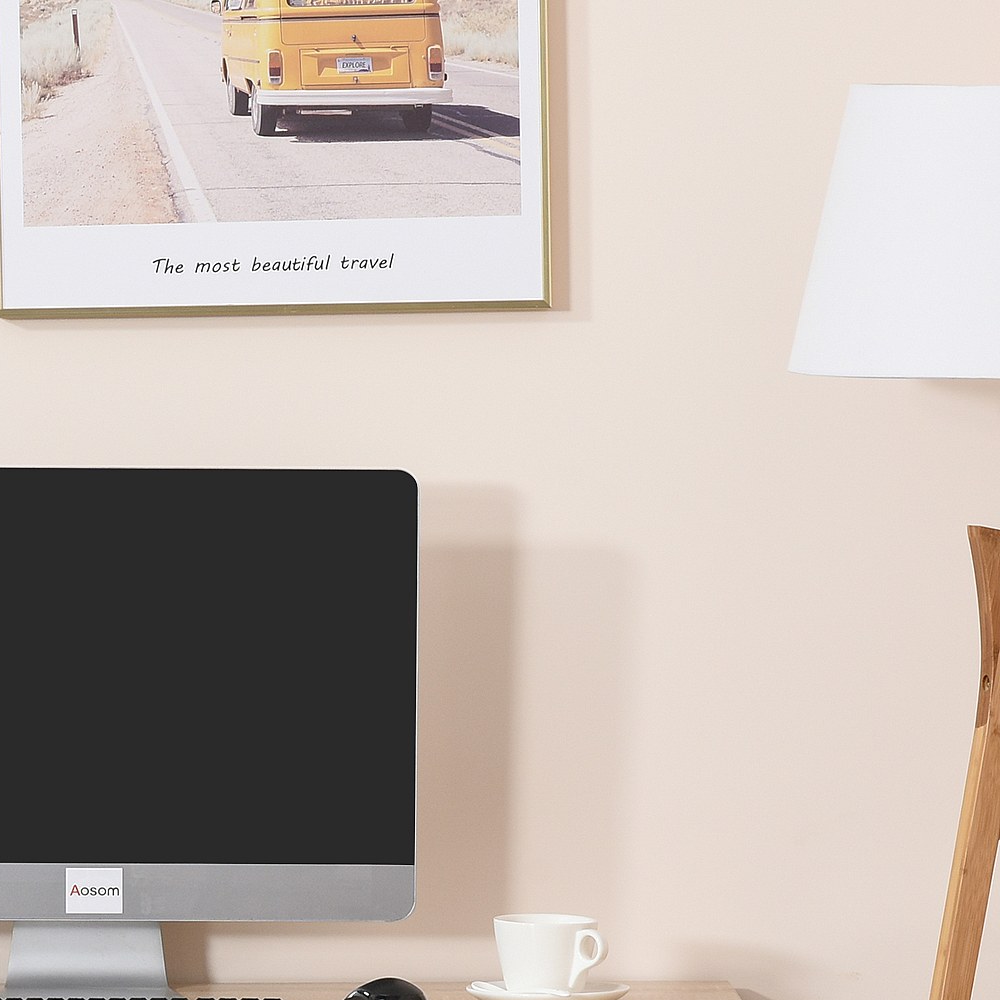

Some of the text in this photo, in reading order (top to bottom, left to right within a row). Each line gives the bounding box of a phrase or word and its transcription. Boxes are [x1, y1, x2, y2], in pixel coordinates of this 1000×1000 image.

[152, 253, 395, 274] The most beautiful travel
[69, 884, 120, 897] Aosom
